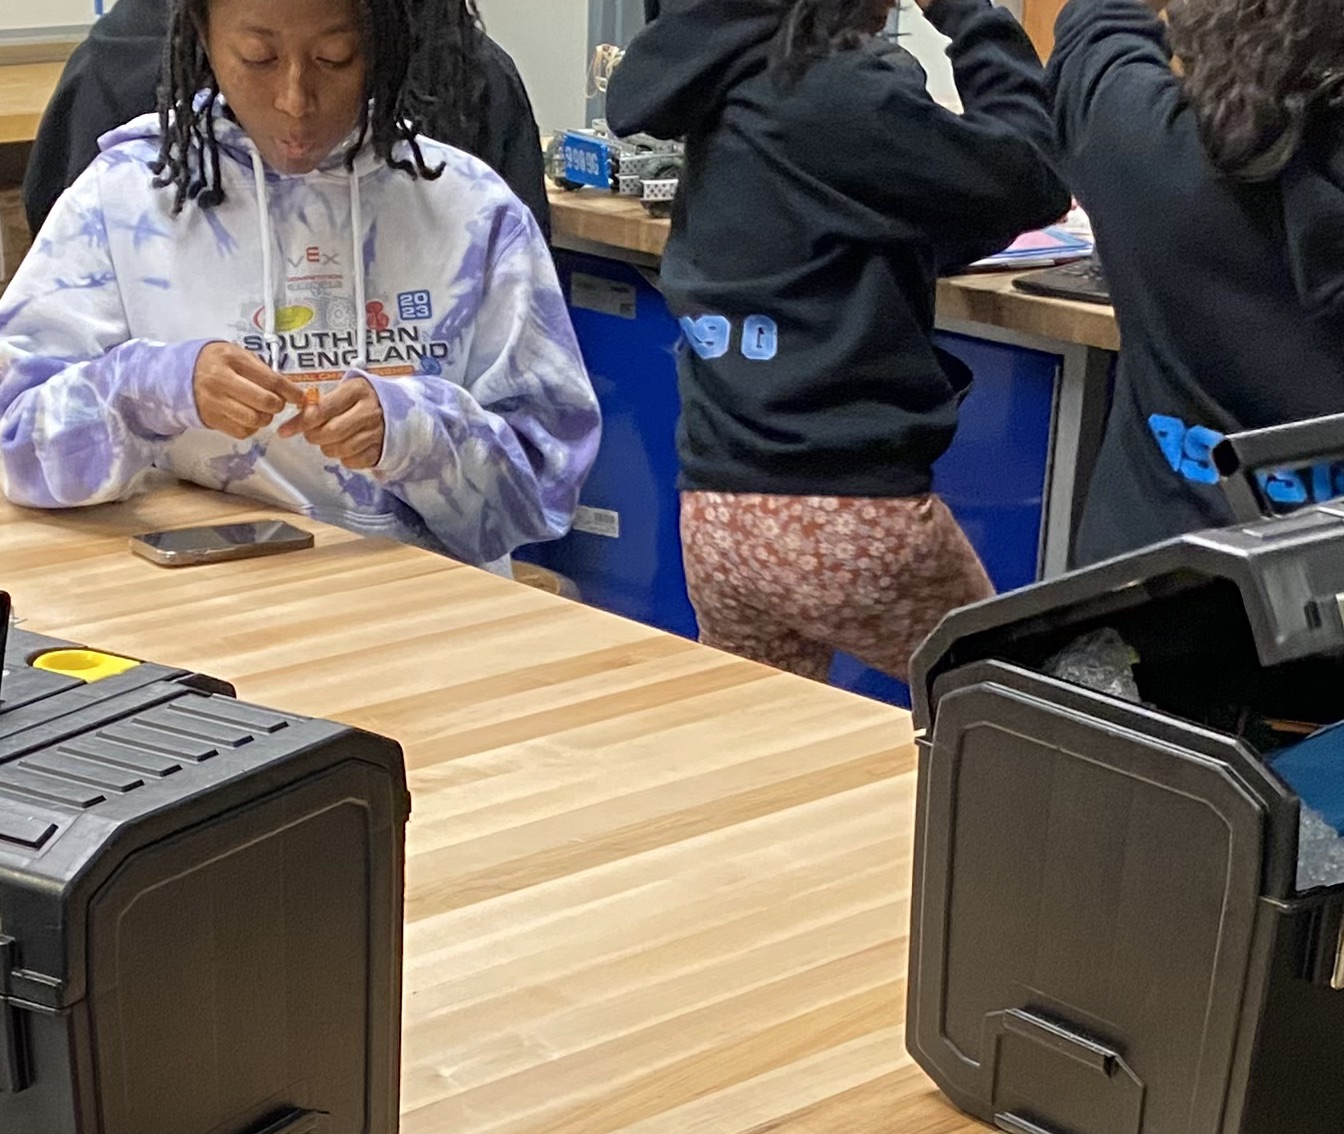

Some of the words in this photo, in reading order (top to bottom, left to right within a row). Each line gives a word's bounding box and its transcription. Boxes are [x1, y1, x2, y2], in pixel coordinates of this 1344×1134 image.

[287, 246, 342, 268] VEX
[399, 292, 429, 306] 20
[401, 304, 430, 319] 23
[298, 342, 448, 369] ENGLAND
